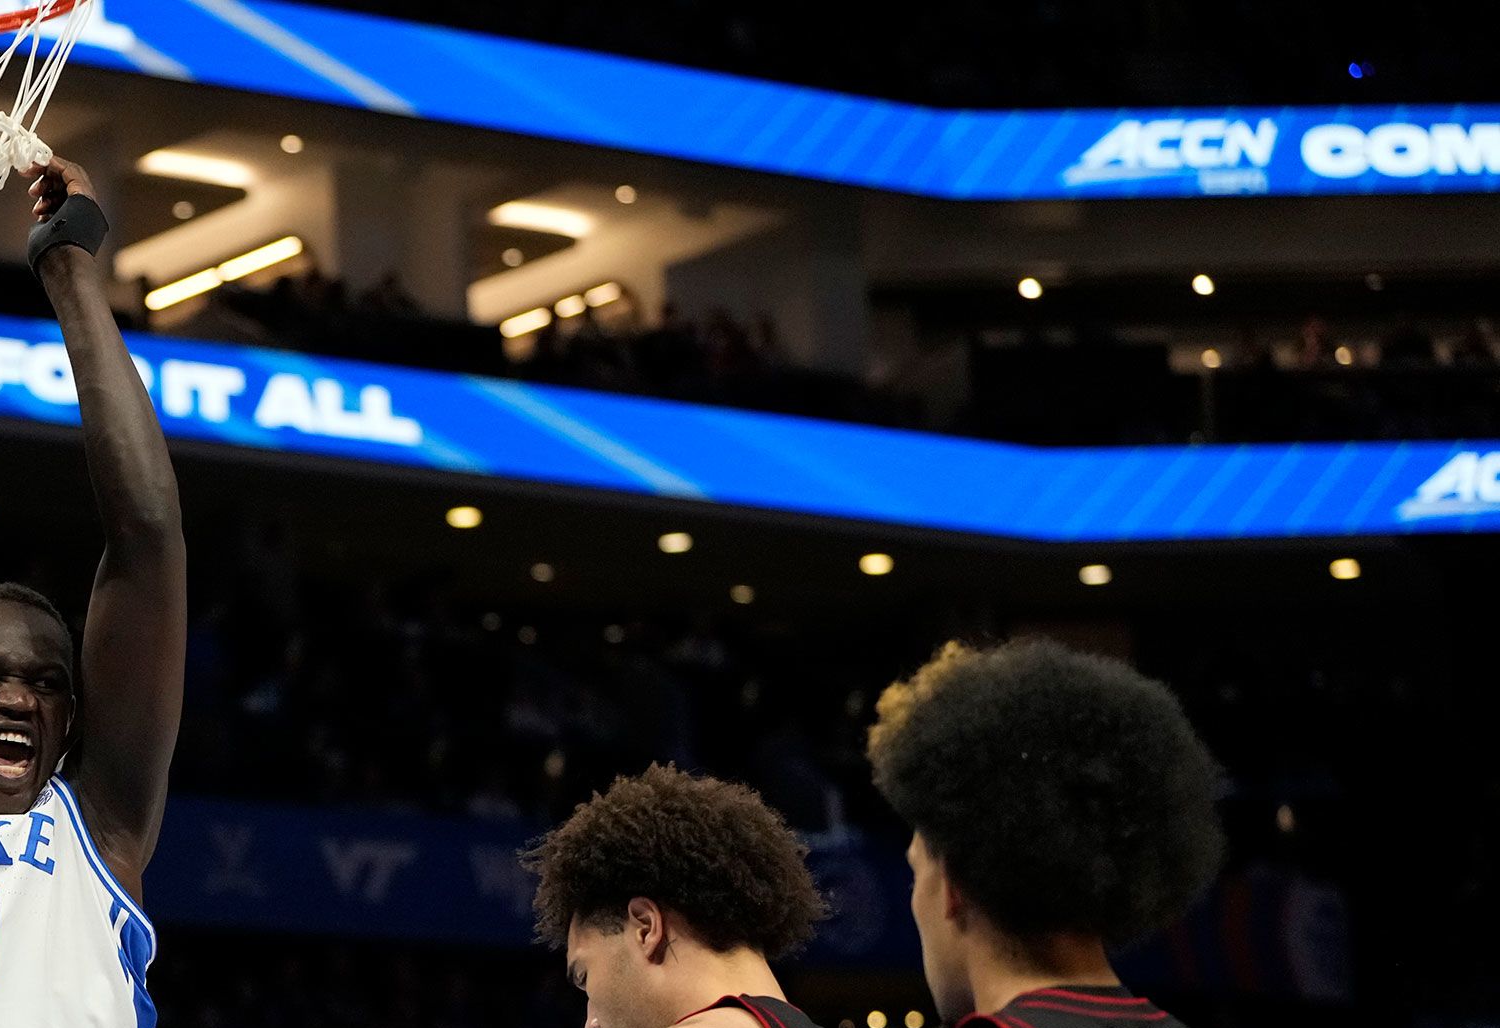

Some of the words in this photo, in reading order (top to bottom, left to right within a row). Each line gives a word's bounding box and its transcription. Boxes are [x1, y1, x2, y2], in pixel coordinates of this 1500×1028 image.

[1072, 118, 1278, 178] ACCN
[160, 360, 246, 422] IT
[254, 373, 423, 446] ALL
